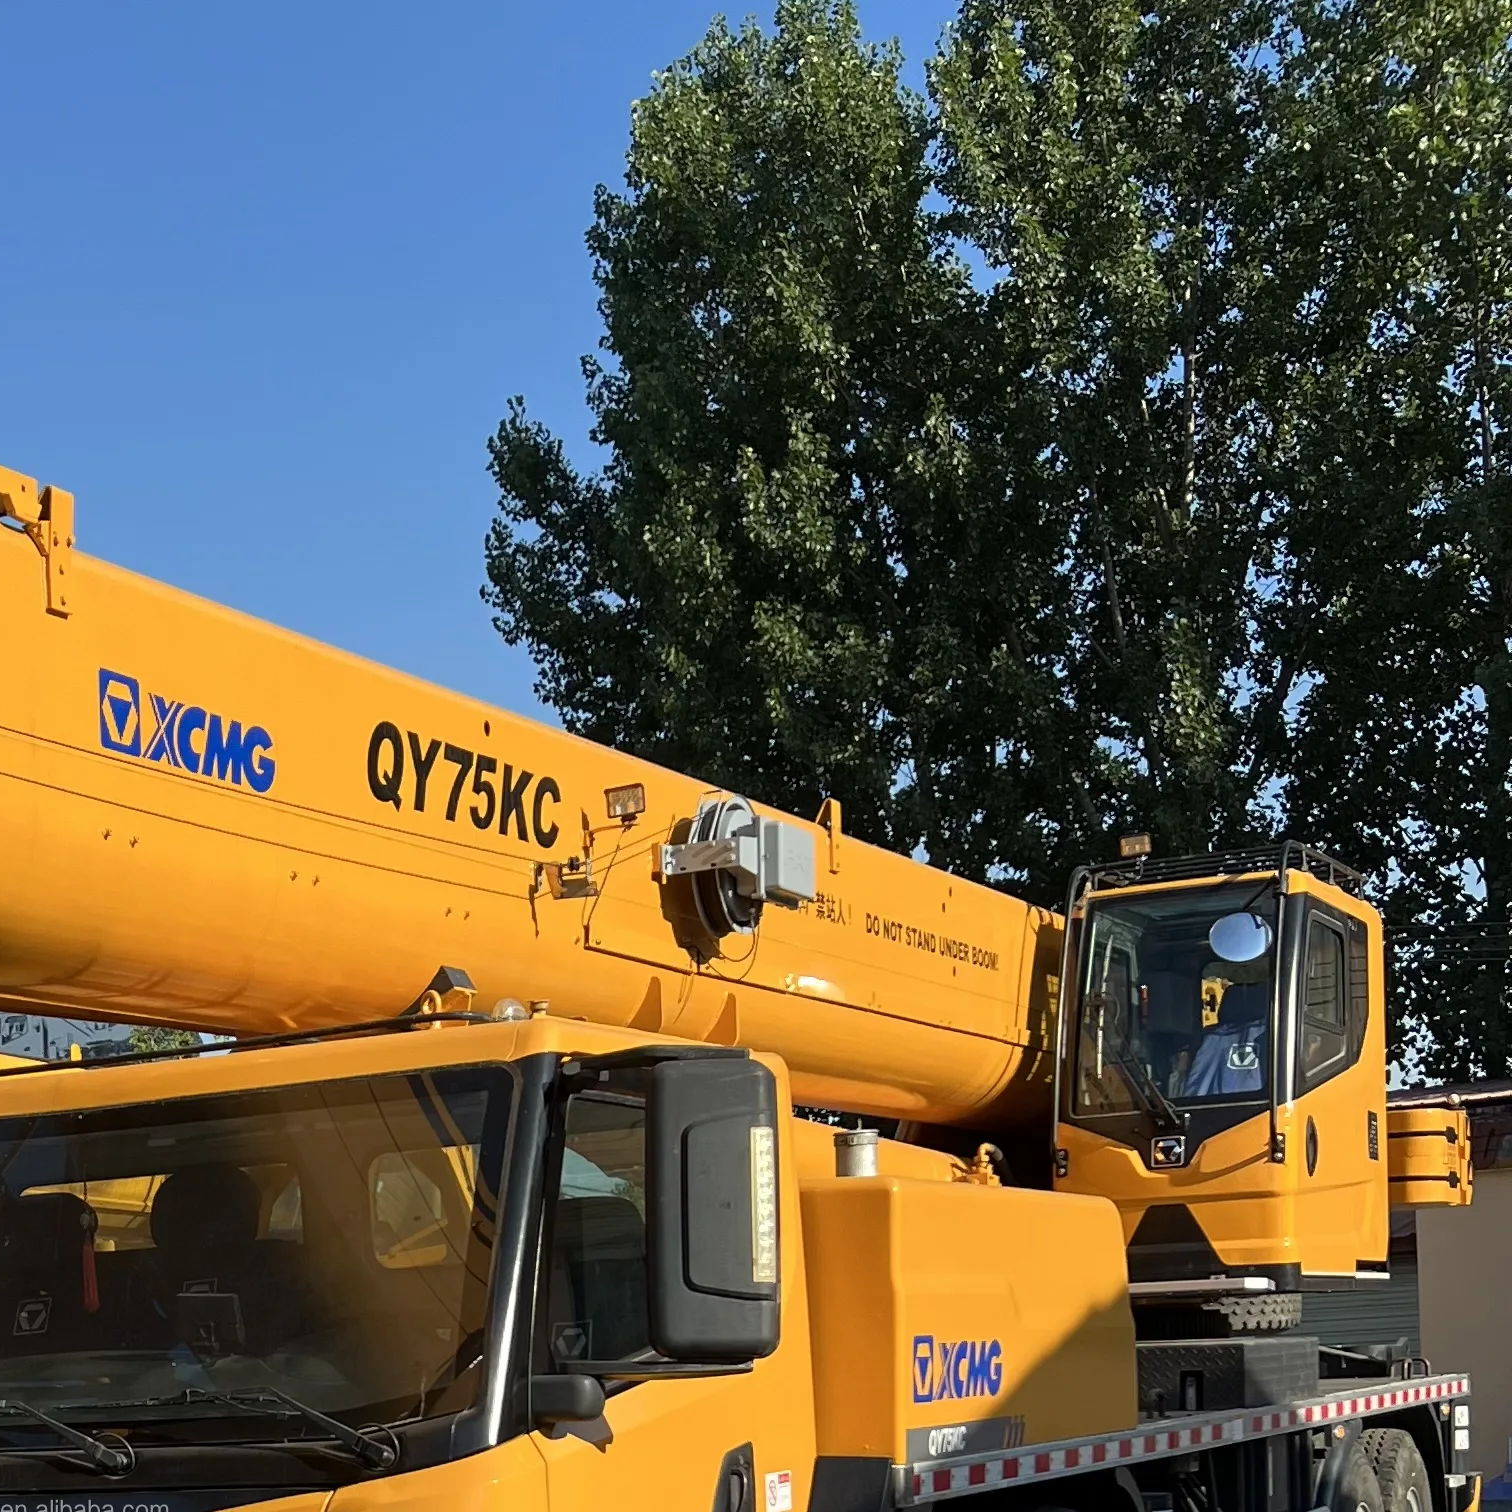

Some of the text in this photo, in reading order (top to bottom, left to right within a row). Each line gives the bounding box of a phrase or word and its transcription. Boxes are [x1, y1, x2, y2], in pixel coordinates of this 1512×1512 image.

[142, 692, 276, 793] XCMG
[367, 720, 562, 849] QY75KC
[865, 912, 999, 972] DO NOT STAND UNDER BOOM!
[932, 1339, 1003, 1400] XCMG
[928, 1426, 968, 1457] QY75KC
